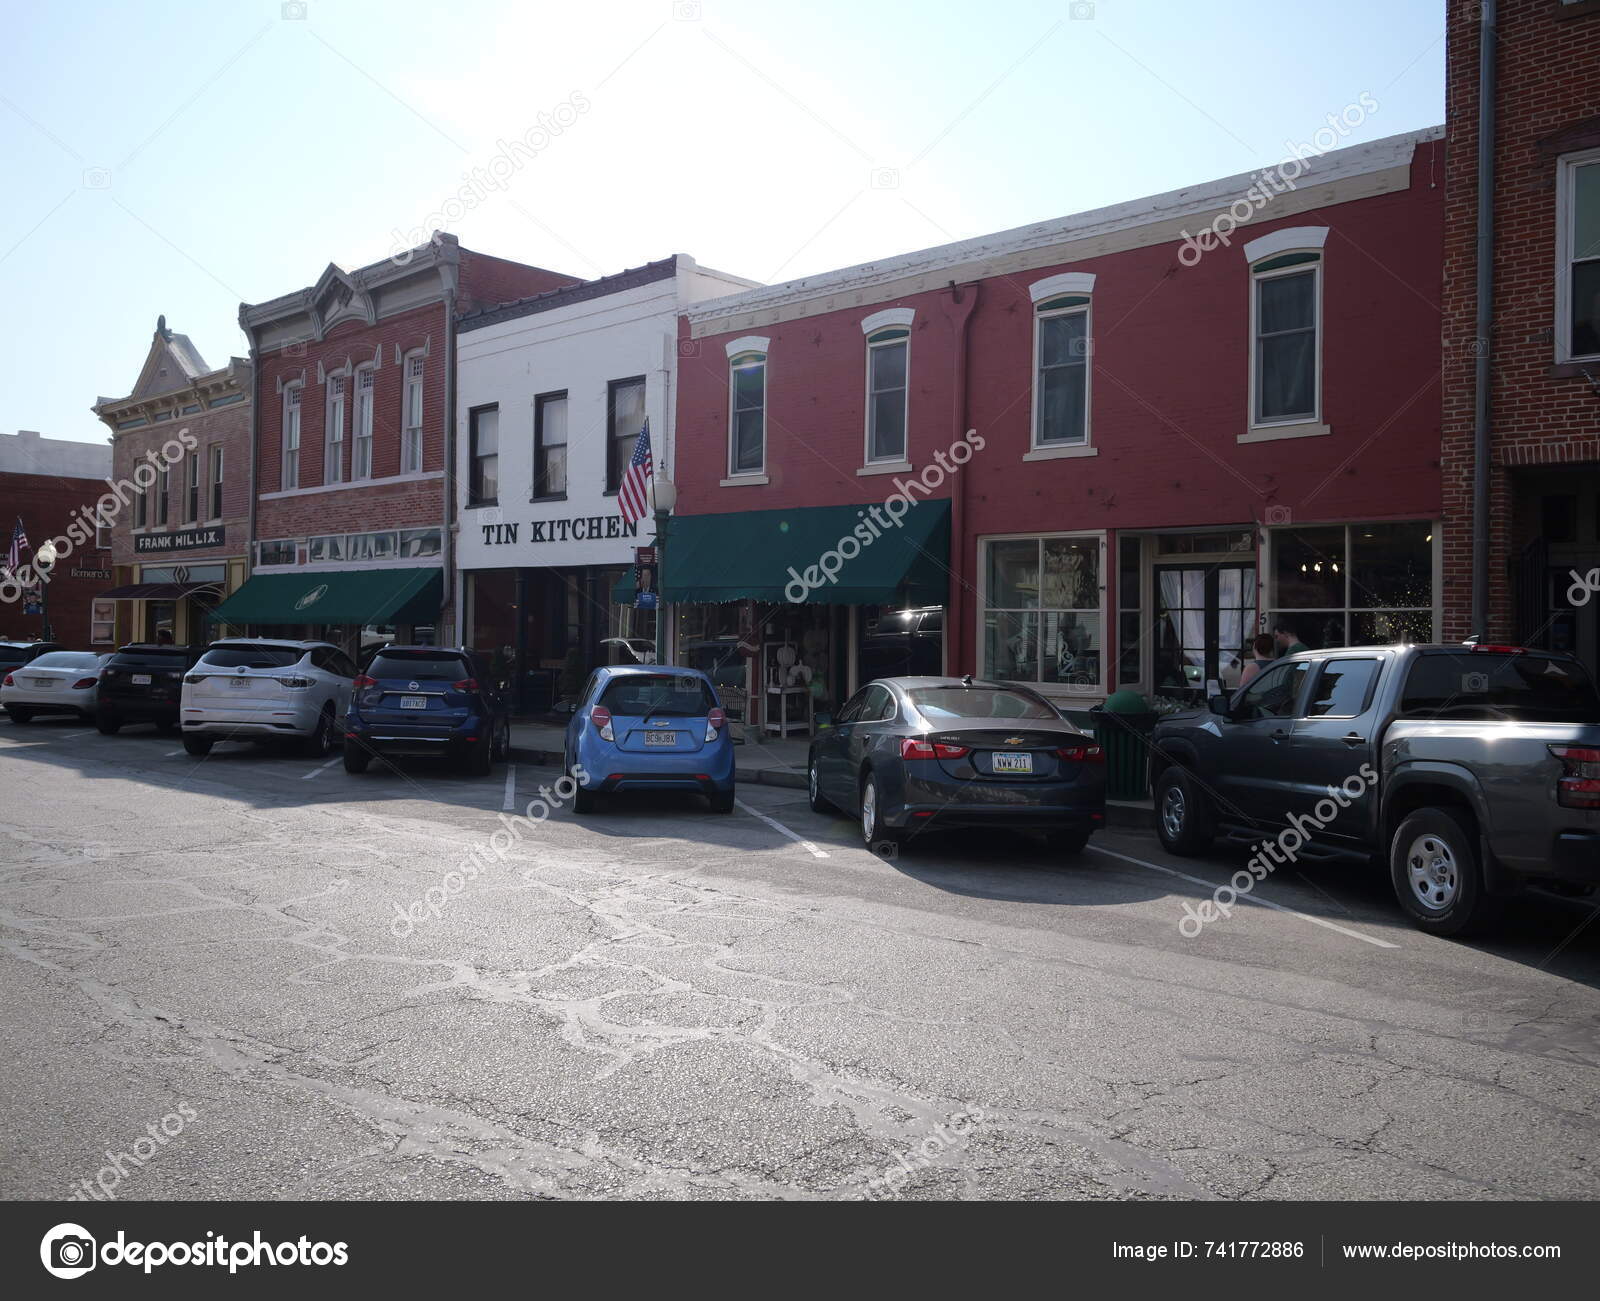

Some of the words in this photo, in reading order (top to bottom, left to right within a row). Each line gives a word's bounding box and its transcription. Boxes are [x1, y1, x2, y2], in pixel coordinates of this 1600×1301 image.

[482, 523, 519, 545] TIN
[530, 515, 638, 543] KITCHEN
[139, 536, 172, 549] FRANK
[997, 758, 1012, 768] NWW
[1014, 759, 1027, 768] 211
